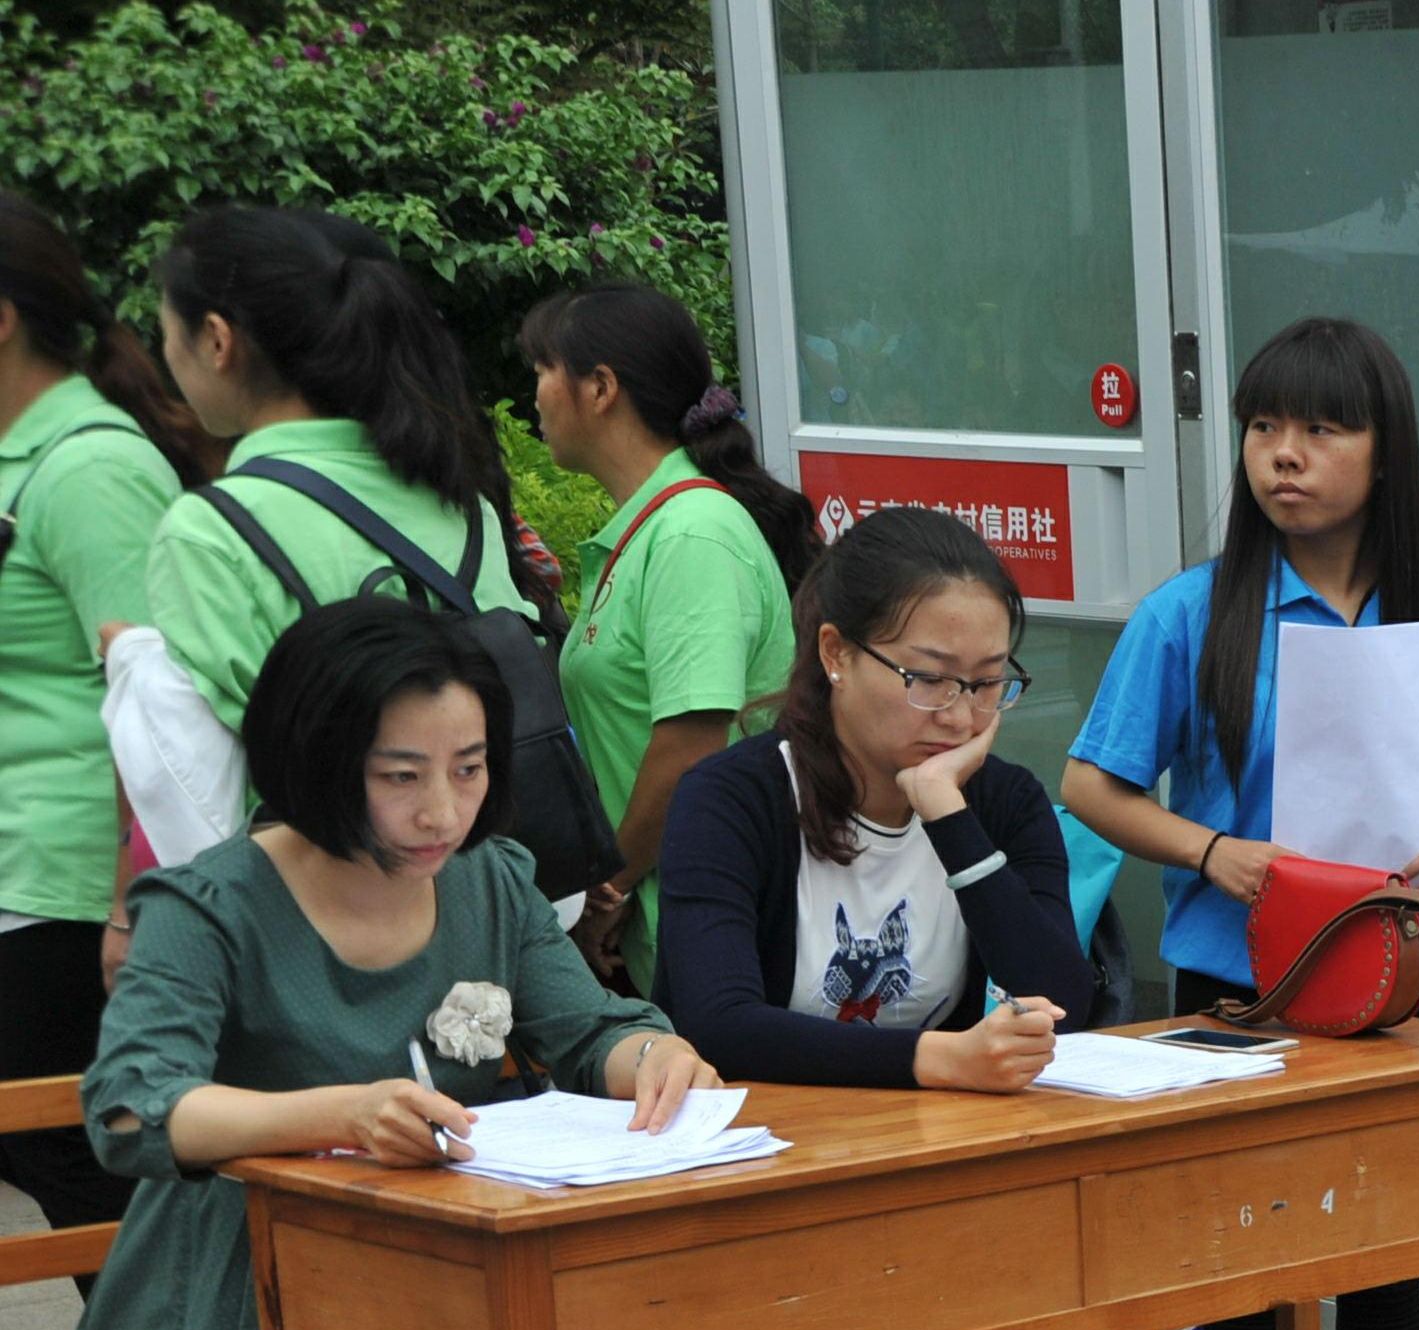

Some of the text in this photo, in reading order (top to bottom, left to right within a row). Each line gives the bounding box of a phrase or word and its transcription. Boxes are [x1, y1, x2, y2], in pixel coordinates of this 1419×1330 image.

[1101, 371, 1121, 400] 拉
[1101, 404, 1122, 416] Pull
[857, 499, 1057, 543] 村信用社
[989, 546, 1057, 560] OPERATIVES
[1240, 1188, 1334, 1228] 6 4
